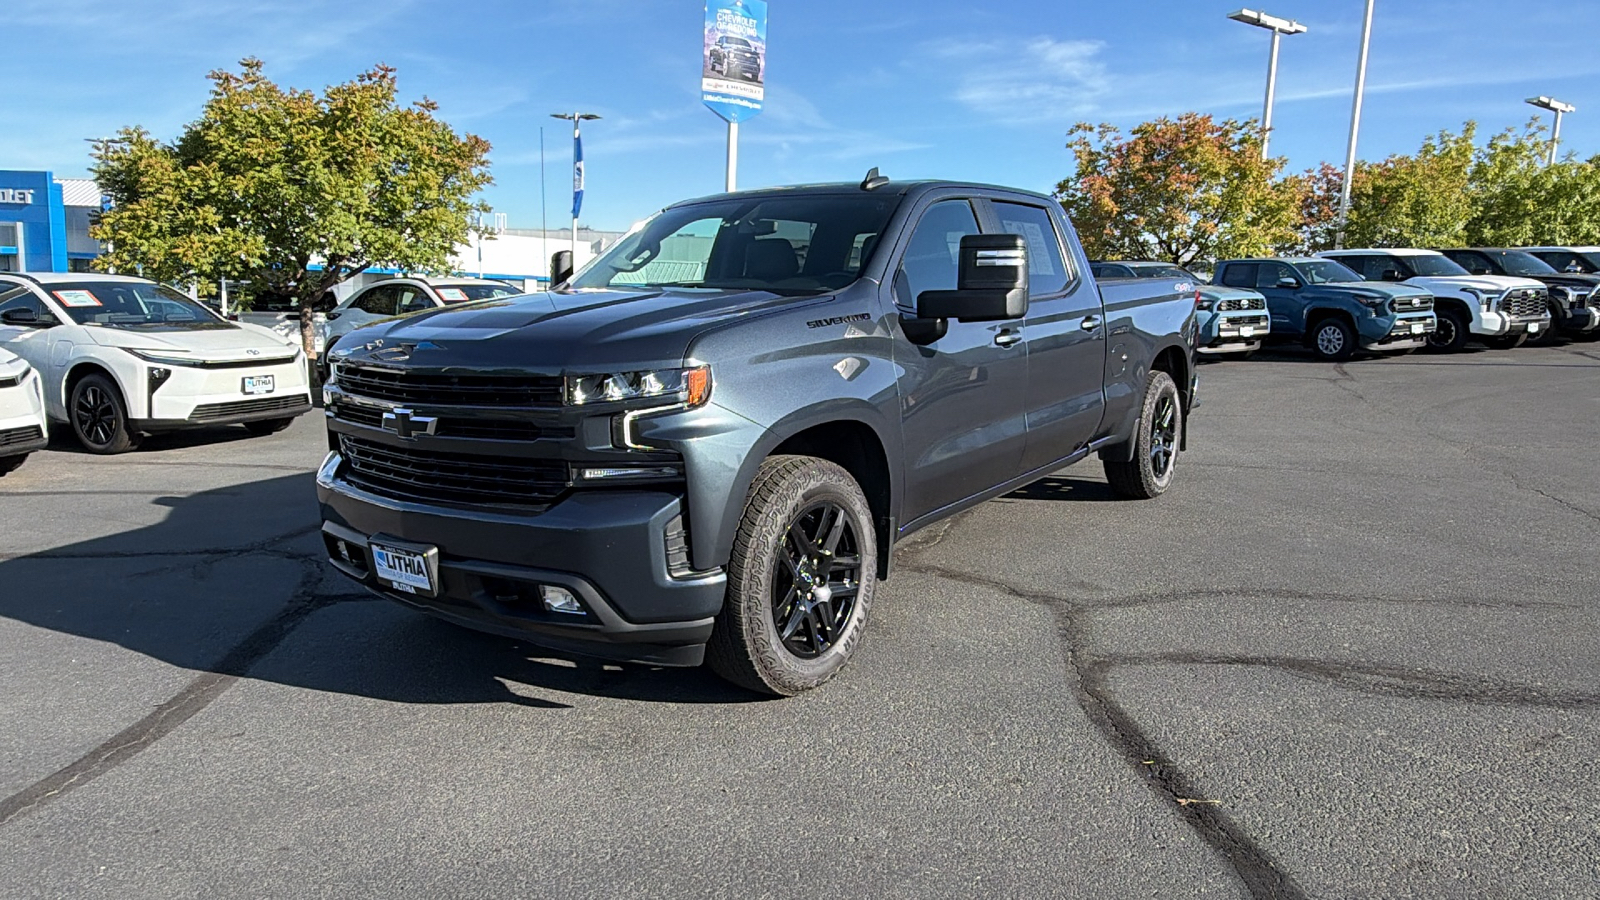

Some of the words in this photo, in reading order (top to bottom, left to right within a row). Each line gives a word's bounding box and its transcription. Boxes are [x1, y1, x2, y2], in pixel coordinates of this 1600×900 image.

[806, 312, 872, 329] SILVERADO
[252, 379, 271, 387] LITHIA
[385, 553, 427, 578] LITHIA
